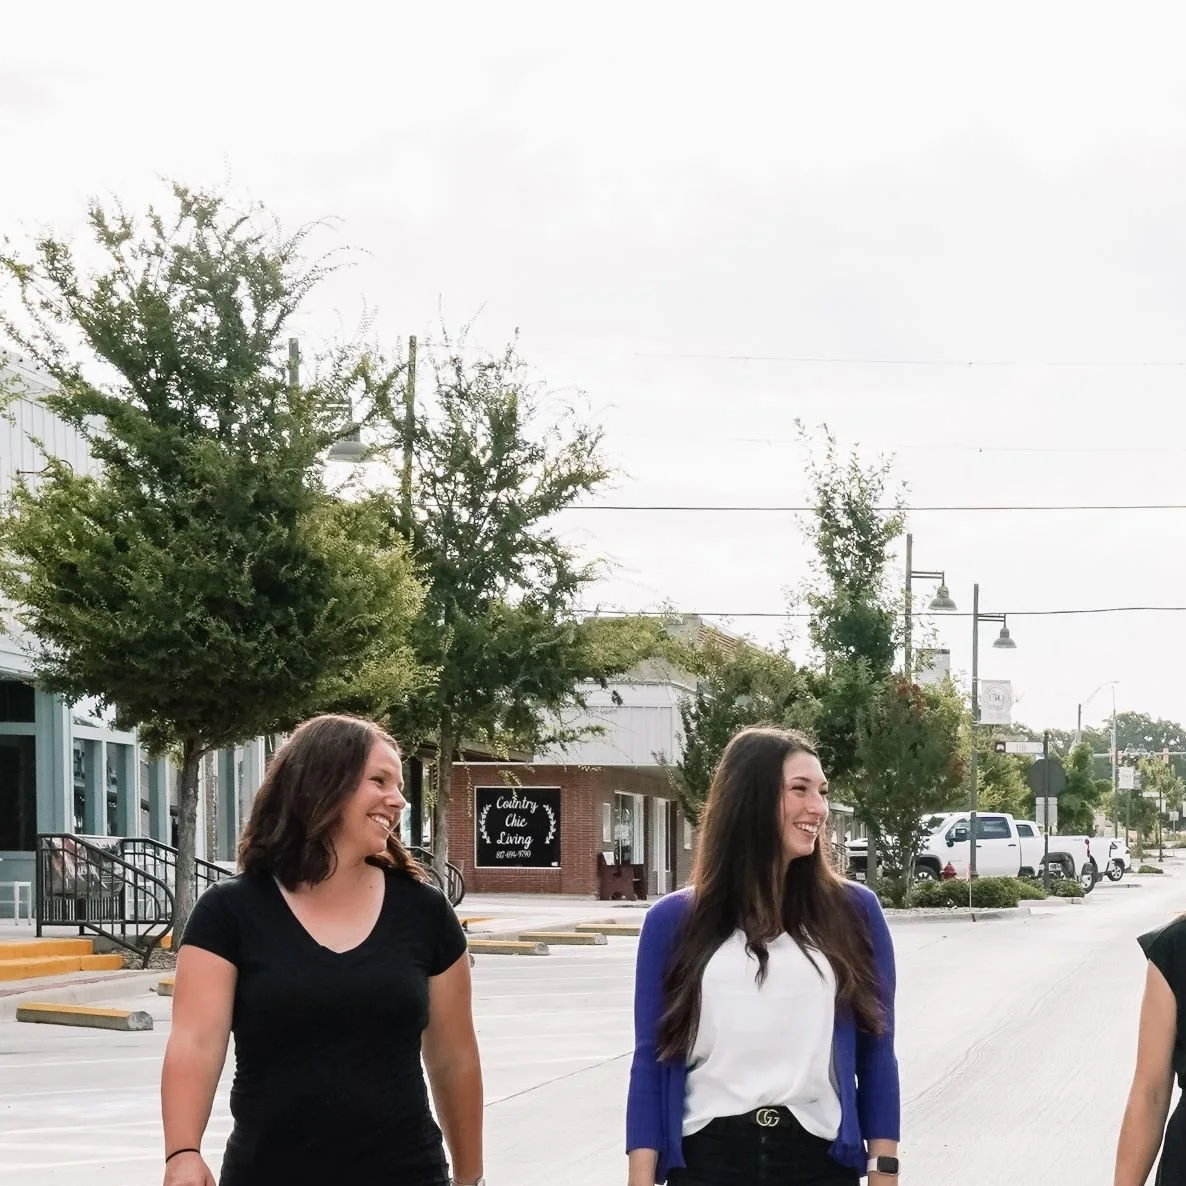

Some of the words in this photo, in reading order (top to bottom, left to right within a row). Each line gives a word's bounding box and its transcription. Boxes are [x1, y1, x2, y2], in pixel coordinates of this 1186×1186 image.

[496, 795, 539, 814] Country
[505, 813, 528, 828] Chic
[496, 831, 534, 850] Living
